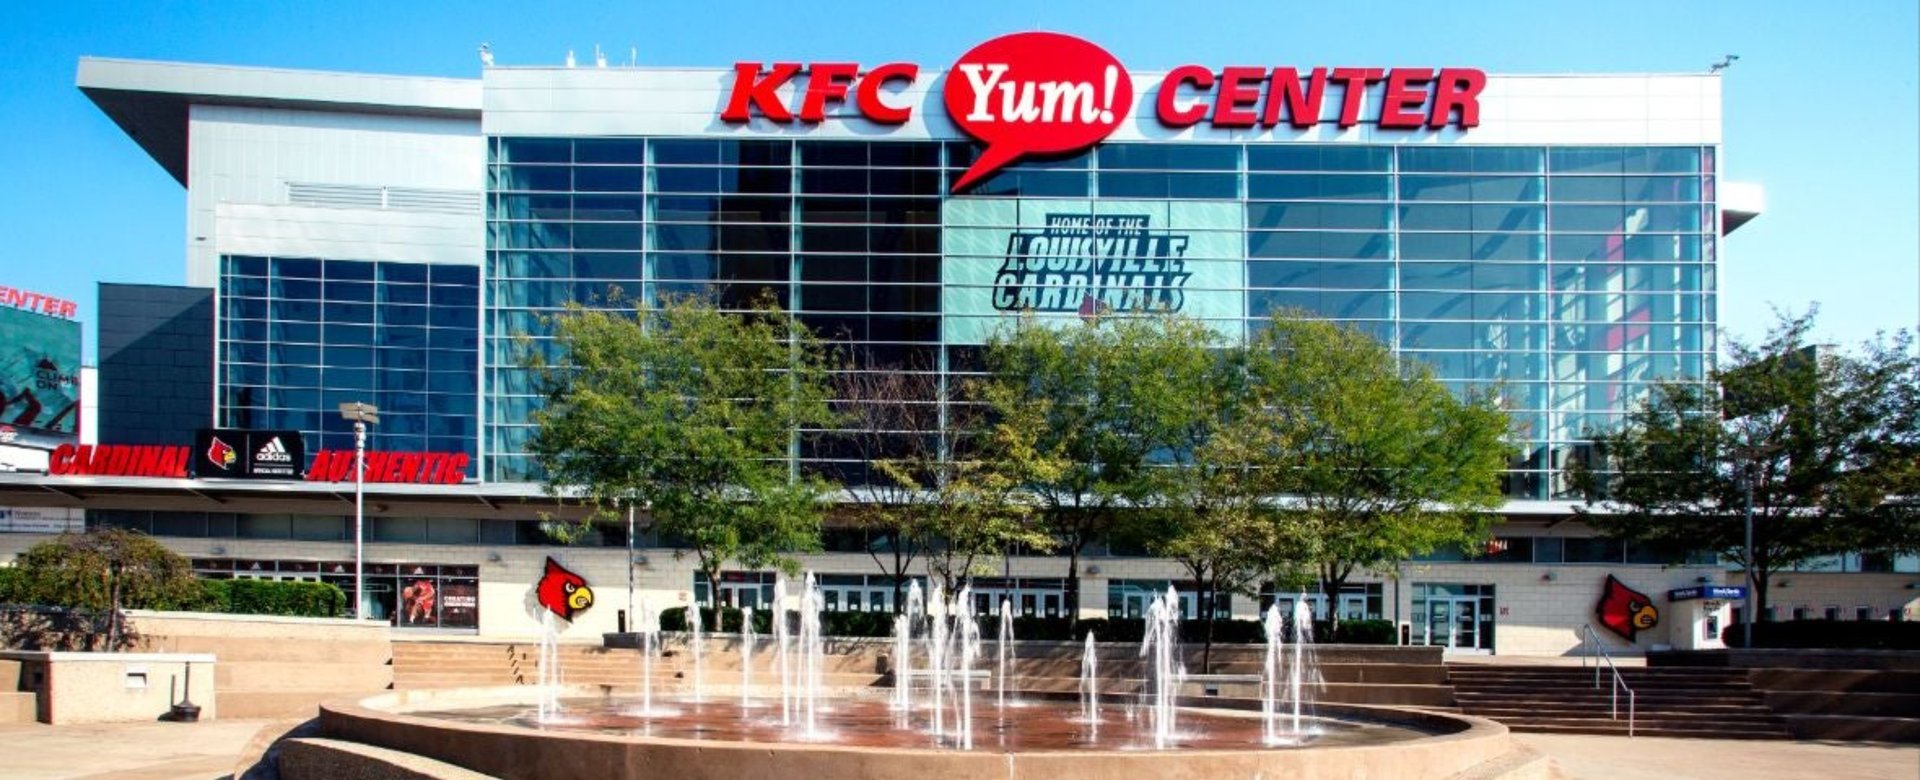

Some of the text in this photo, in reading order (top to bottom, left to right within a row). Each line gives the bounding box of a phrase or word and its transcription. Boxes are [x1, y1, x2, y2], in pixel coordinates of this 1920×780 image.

[720, 63, 1487, 129] KFC Yum! CENTER
[1051, 217, 1144, 236] HOME OF THE
[1006, 236, 1186, 272] LOUISVILLE
[994, 272, 1186, 310] CARDINALS
[37, 381, 58, 390] ON
[50, 443, 190, 477] CARDINAL
[256, 452, 292, 462] adidas
